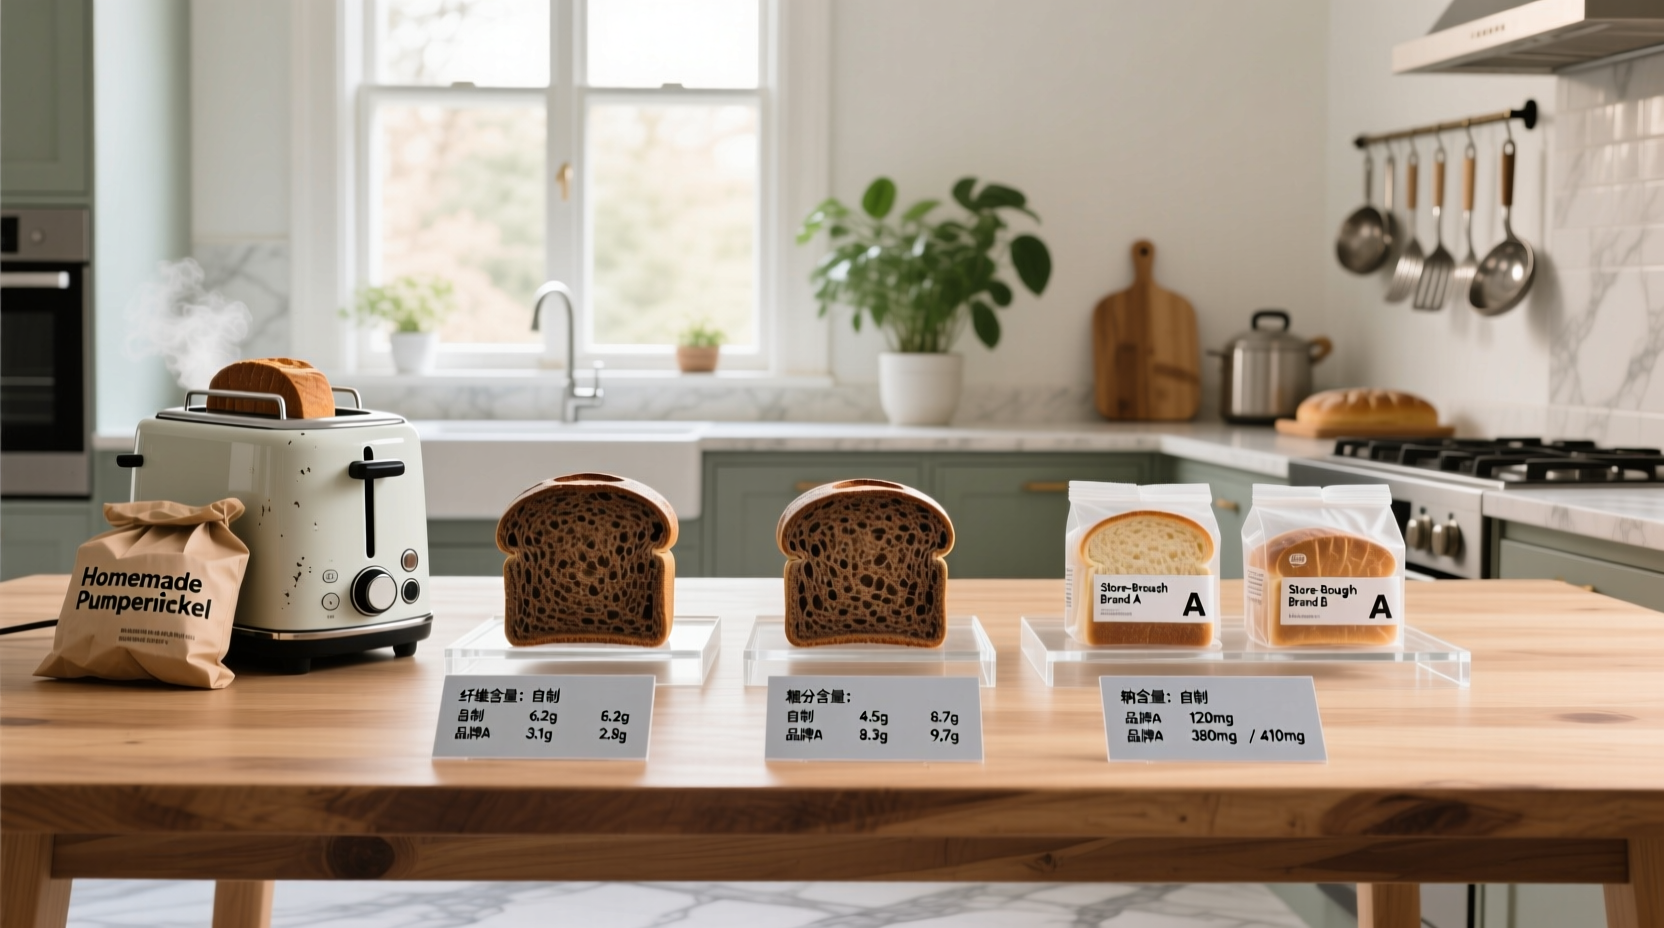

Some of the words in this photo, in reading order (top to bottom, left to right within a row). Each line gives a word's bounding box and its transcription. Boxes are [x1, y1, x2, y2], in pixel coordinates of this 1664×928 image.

[81, 566, 203, 594] Homemade
[1100, 593, 1131, 605] Brand
[1133, 593, 1142, 605] A
[1182, 592, 1206, 617] A
[1288, 596, 1319, 608] Brand
[1320, 596, 1328, 608] B
[1368, 594, 1393, 619] A
[532, 687, 561, 704] 自制
[529, 709, 558, 725] 6.2g
[600, 709, 630, 726] 6.2g
[787, 709, 815, 724] 自制
[859, 710, 889, 726] 4.5g
[1189, 711, 1234, 727] 120mg
[859, 728, 888, 744] 8.3g
[930, 728, 960, 745] 9.7g
[1191, 729, 1238, 745] 380mg
[1249, 729, 1256, 744] /
[1260, 729, 1306, 745] 410mg
